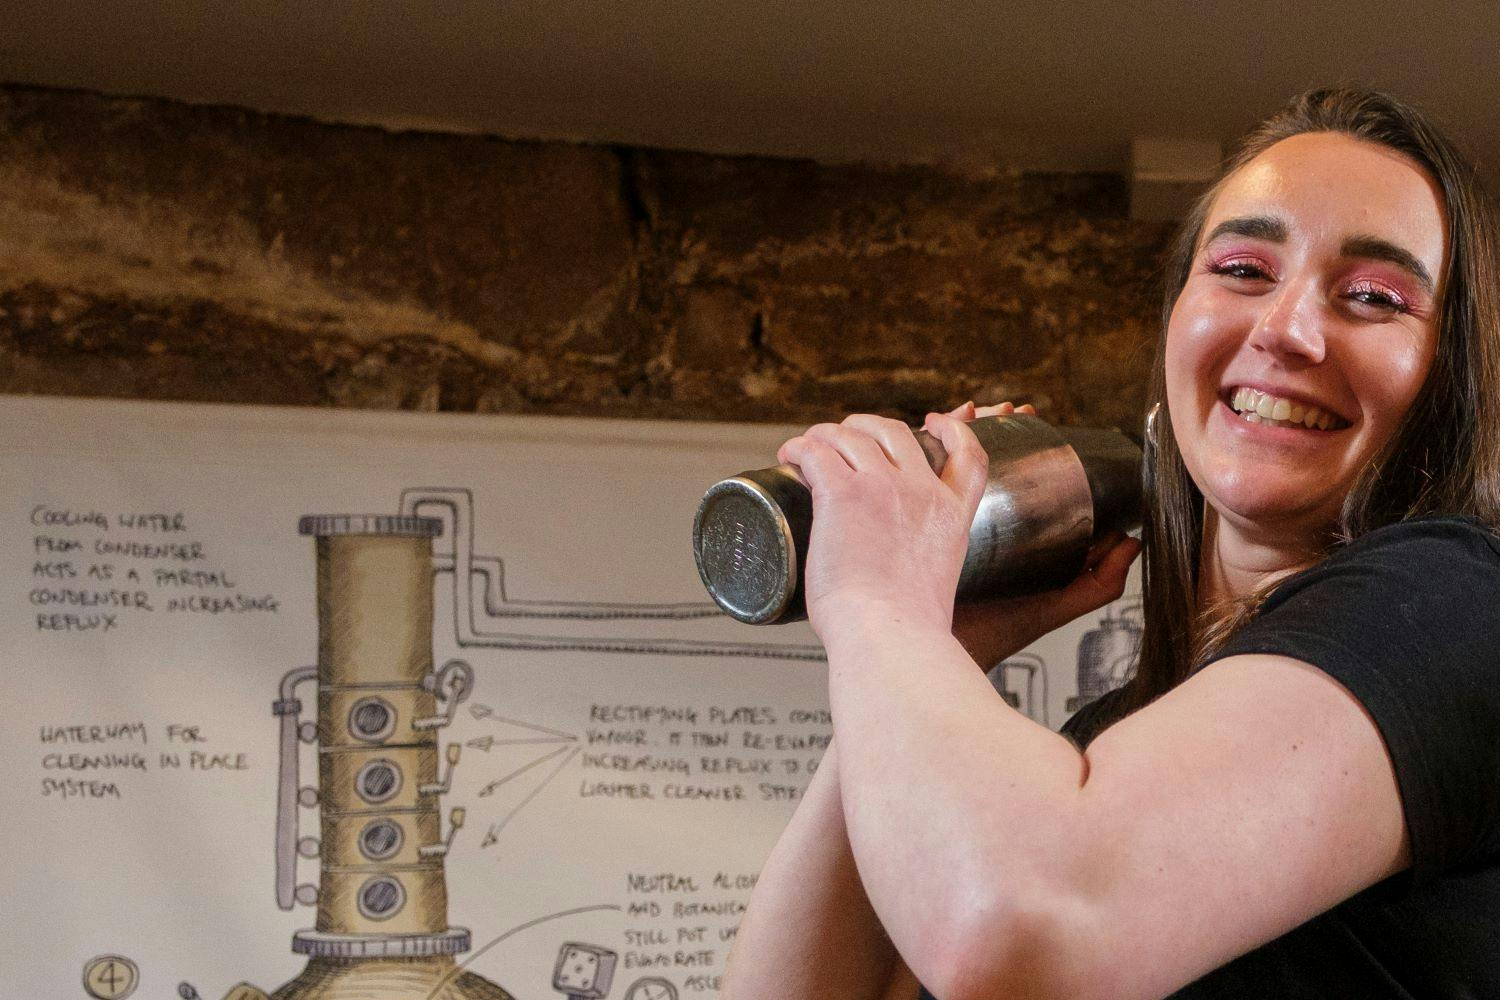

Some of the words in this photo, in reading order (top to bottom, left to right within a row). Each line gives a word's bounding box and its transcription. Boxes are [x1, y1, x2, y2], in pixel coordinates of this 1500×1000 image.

[31, 504, 108, 530] COOLING
[119, 512, 186, 532] WATER
[33, 561, 77, 577] ACTS
[88, 563, 113, 579] AS
[128, 568, 140, 583] A
[155, 568, 235, 588] PARTIAL
[37, 613, 118, 631] REFLUX
[166, 725, 206, 743] FOR
[159, 753, 181, 769] IN
[190, 752, 250, 771] PLACE
[40, 777, 121, 799] SYSTEM
[627, 872, 699, 893] NEUTRAL
[624, 928, 669, 946] STILL
[677, 926, 708, 943] POT
[97, 962, 124, 993] 4
